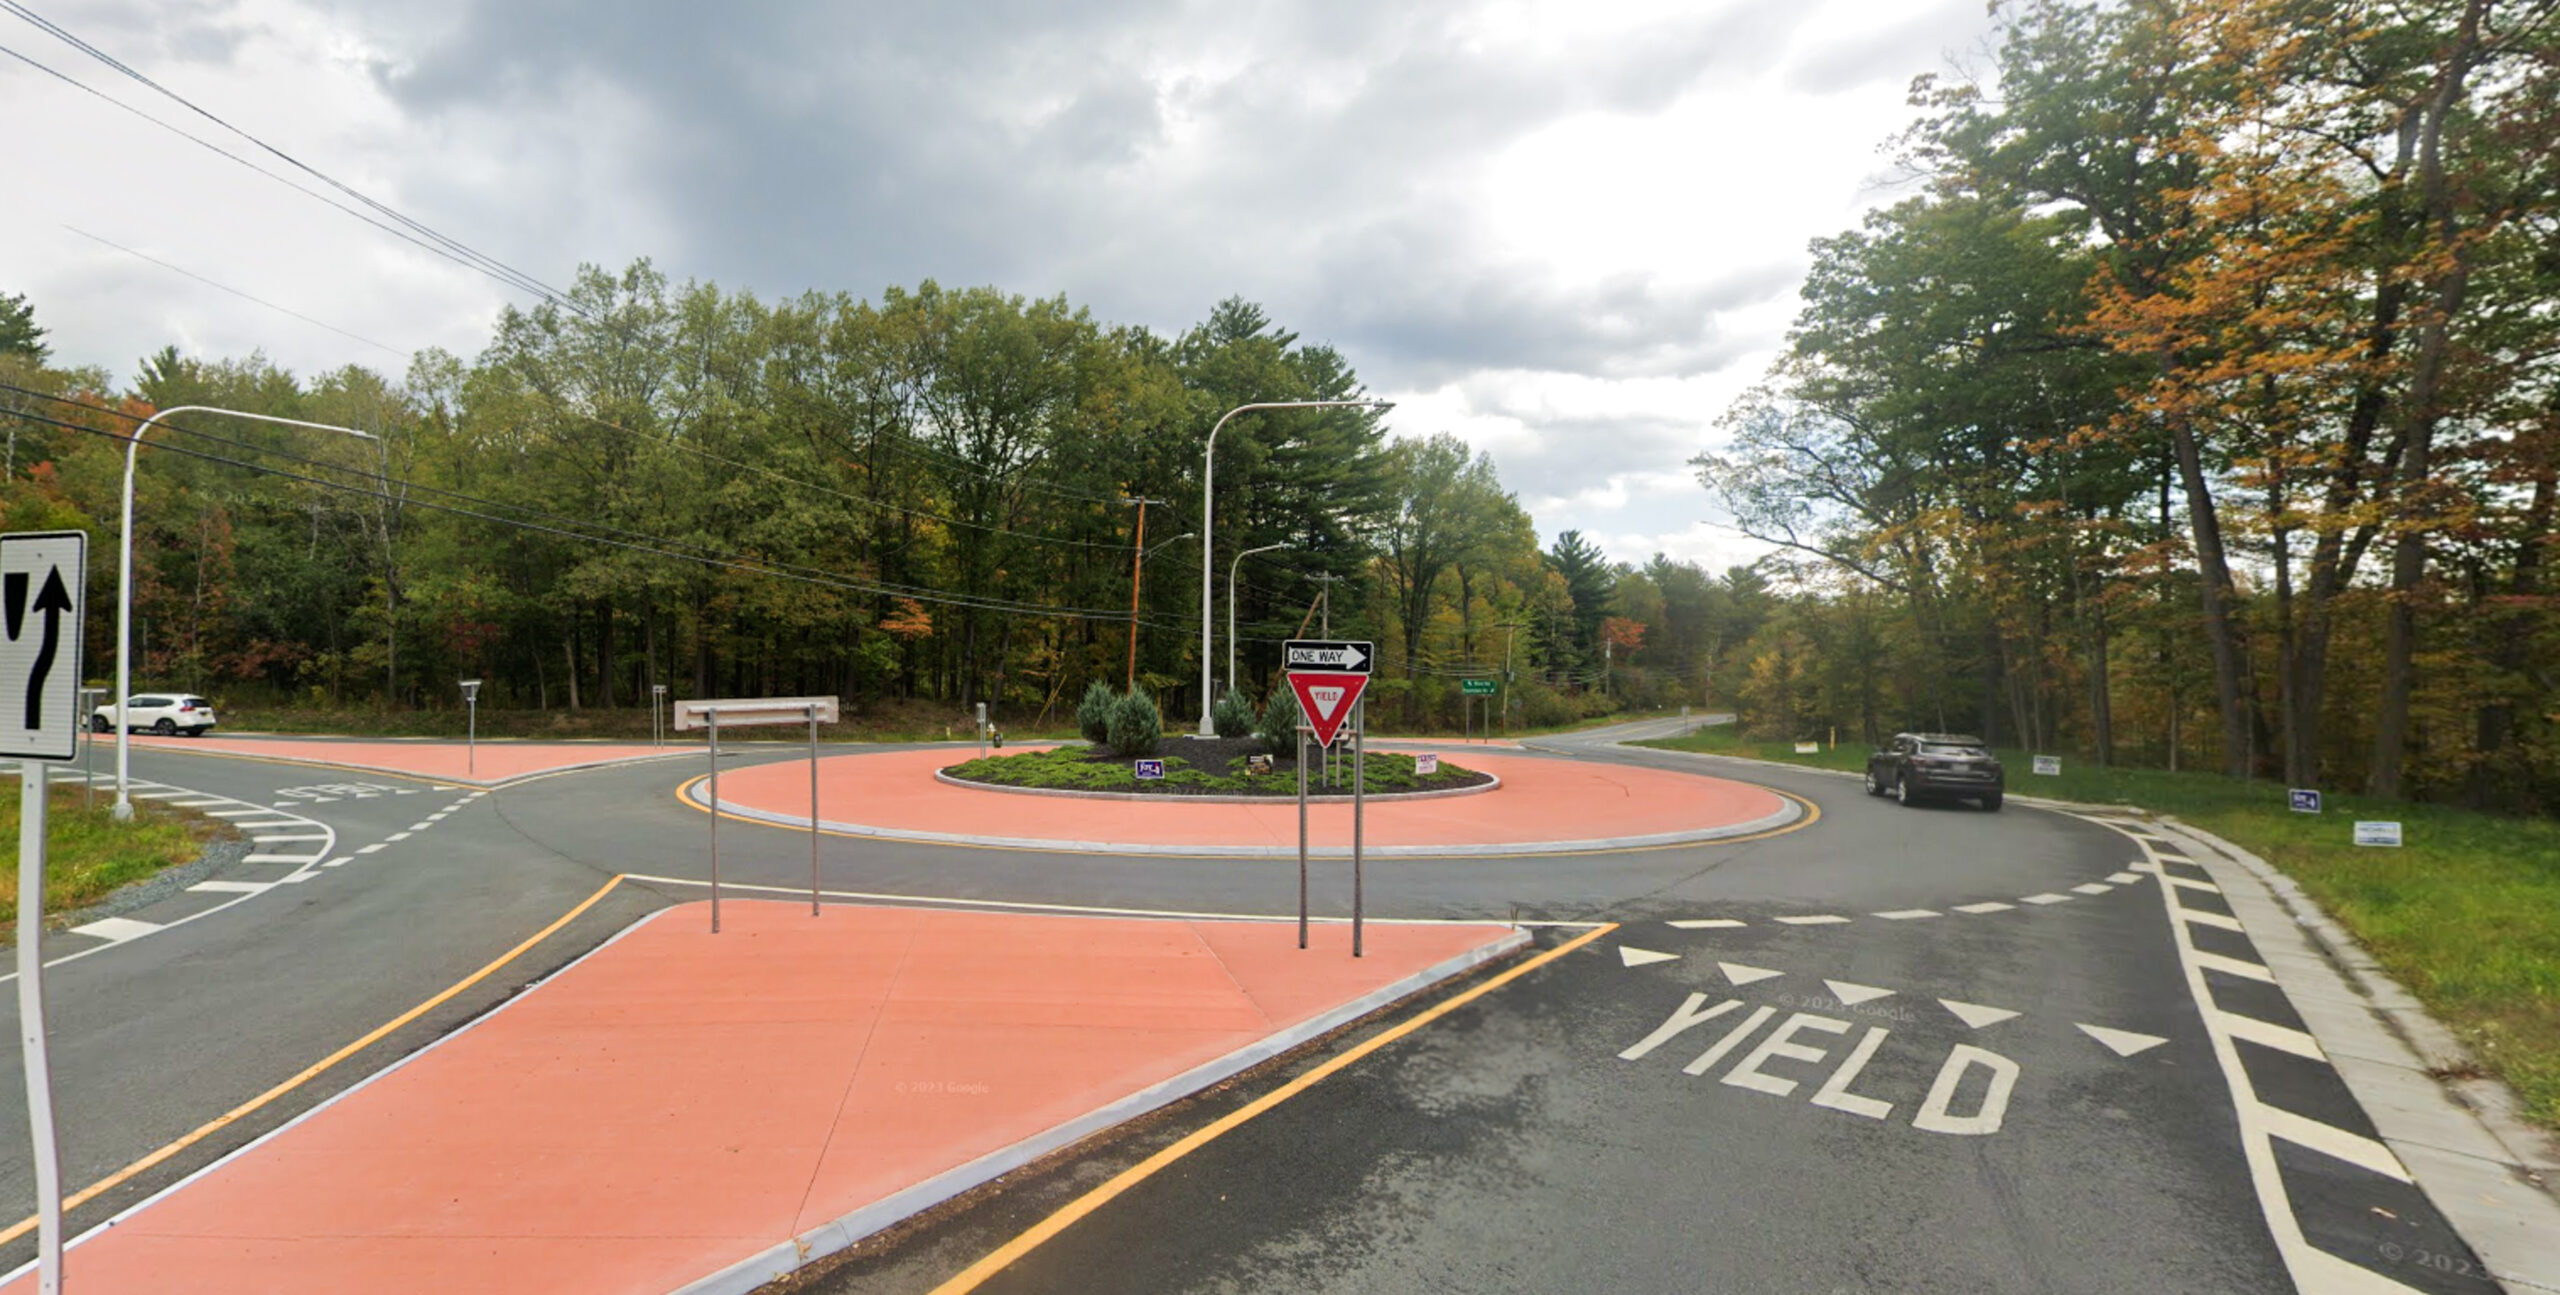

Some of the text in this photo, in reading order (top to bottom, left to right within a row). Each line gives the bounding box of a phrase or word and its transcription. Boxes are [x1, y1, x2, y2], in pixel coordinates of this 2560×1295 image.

[1292, 649, 1344, 663] ONE WAY
[1314, 691, 1338, 701] YIELD
[1617, 992, 2020, 1135] YIELD
